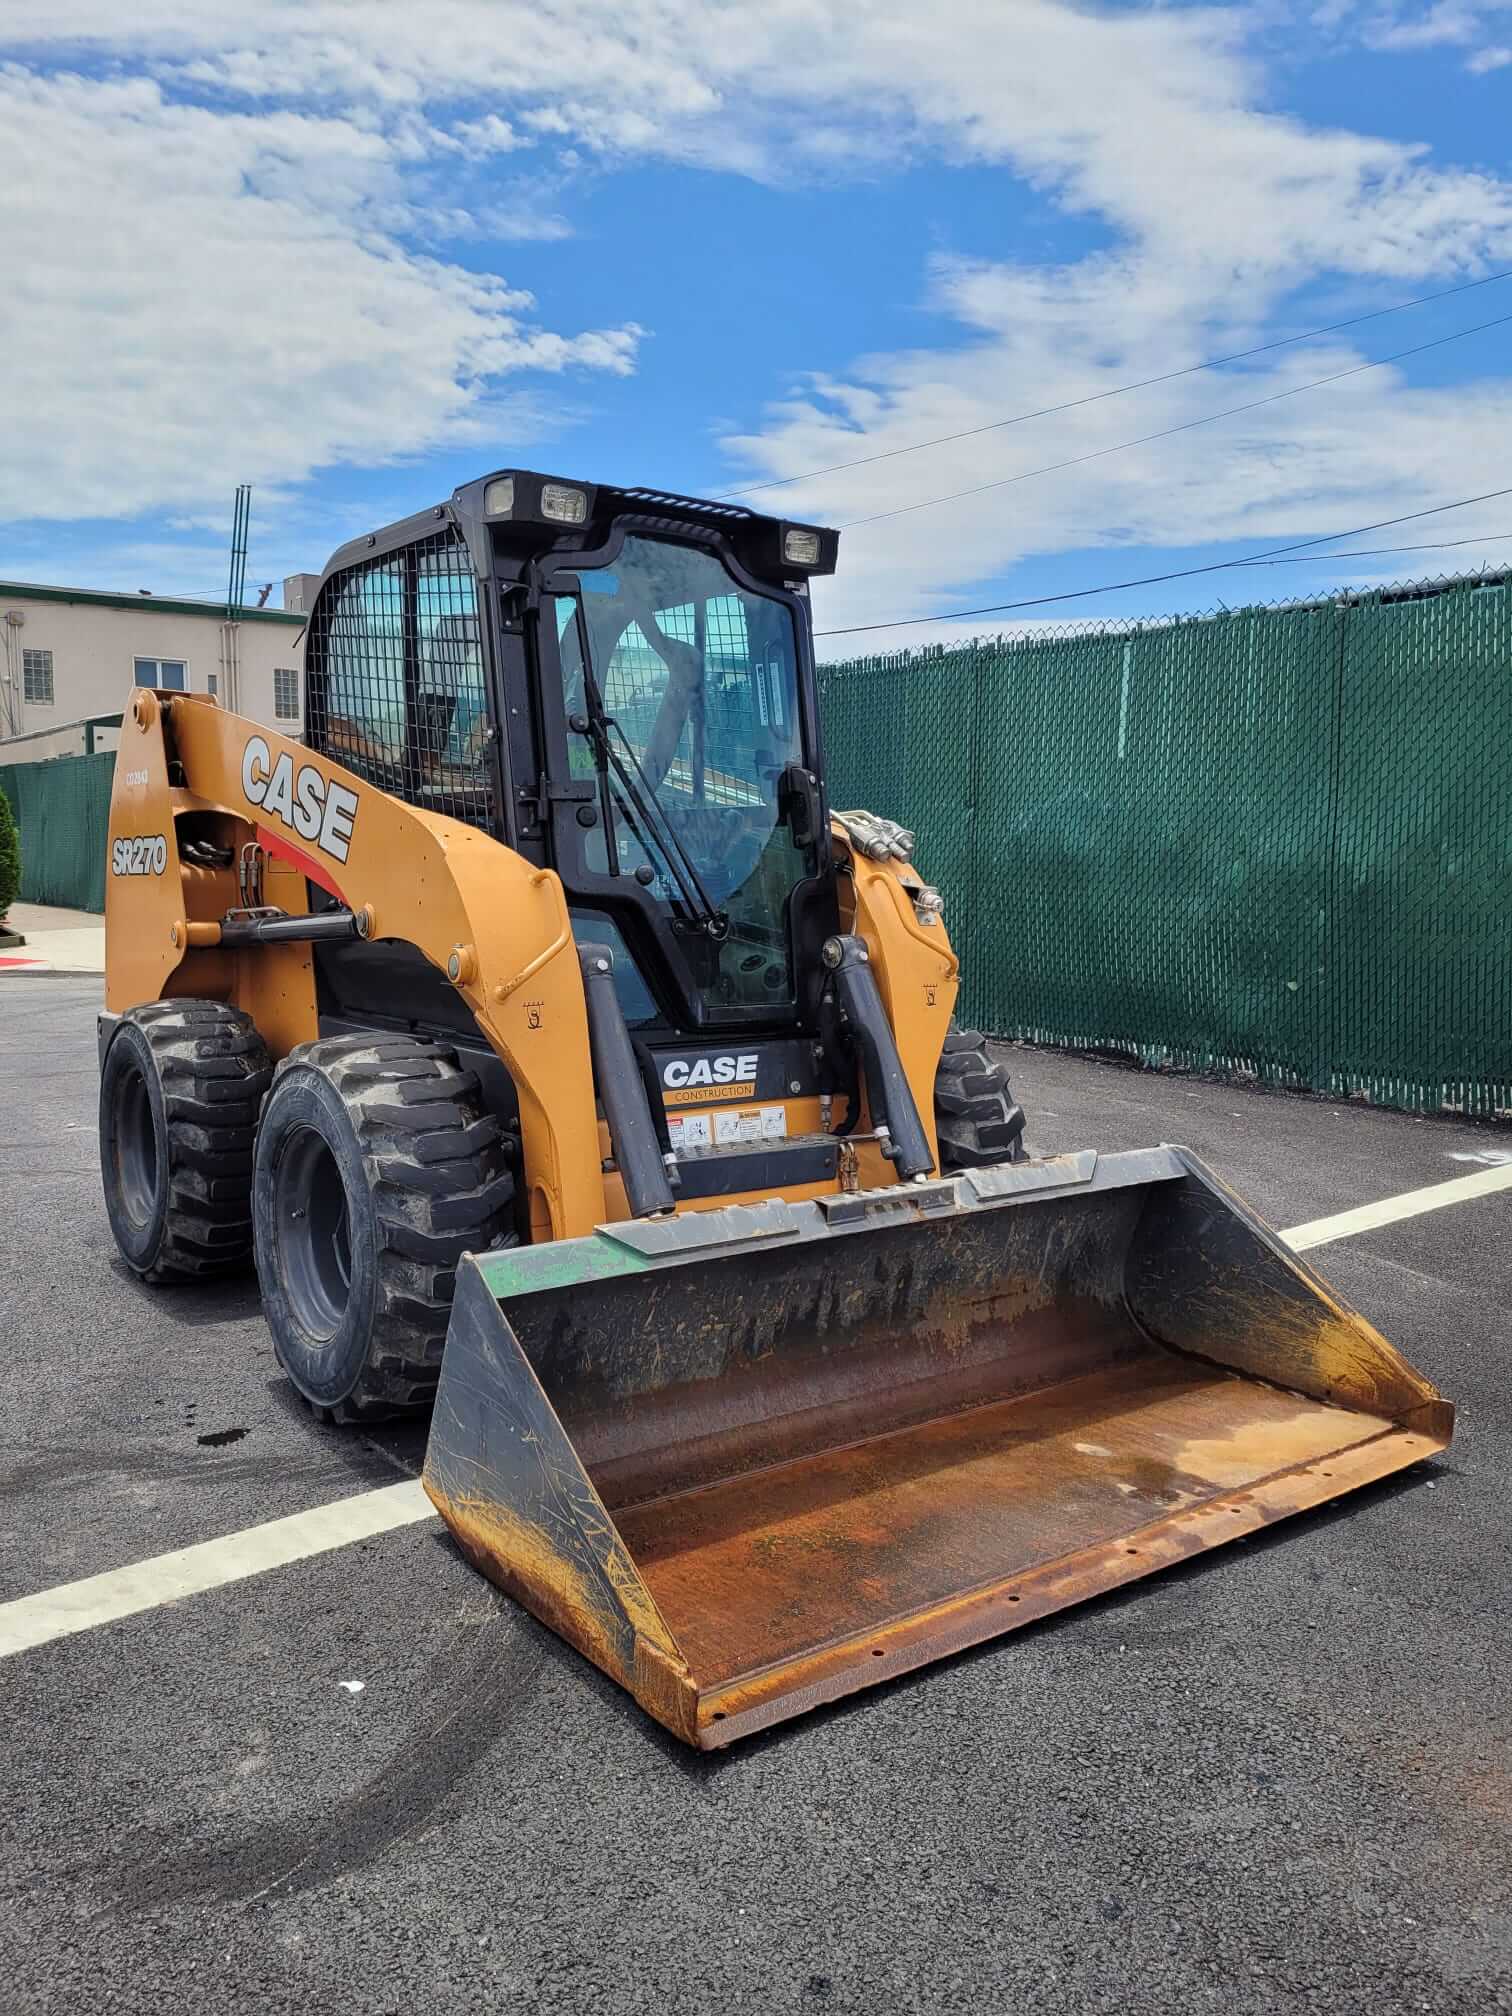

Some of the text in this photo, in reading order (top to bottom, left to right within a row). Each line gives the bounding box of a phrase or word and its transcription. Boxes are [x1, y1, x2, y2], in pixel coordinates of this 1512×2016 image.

[242, 735, 359, 866] CASE
[112, 834, 167, 876] SR270
[663, 1054, 759, 1088] CASE
[675, 1085, 752, 1102] CONSTRUCTION
